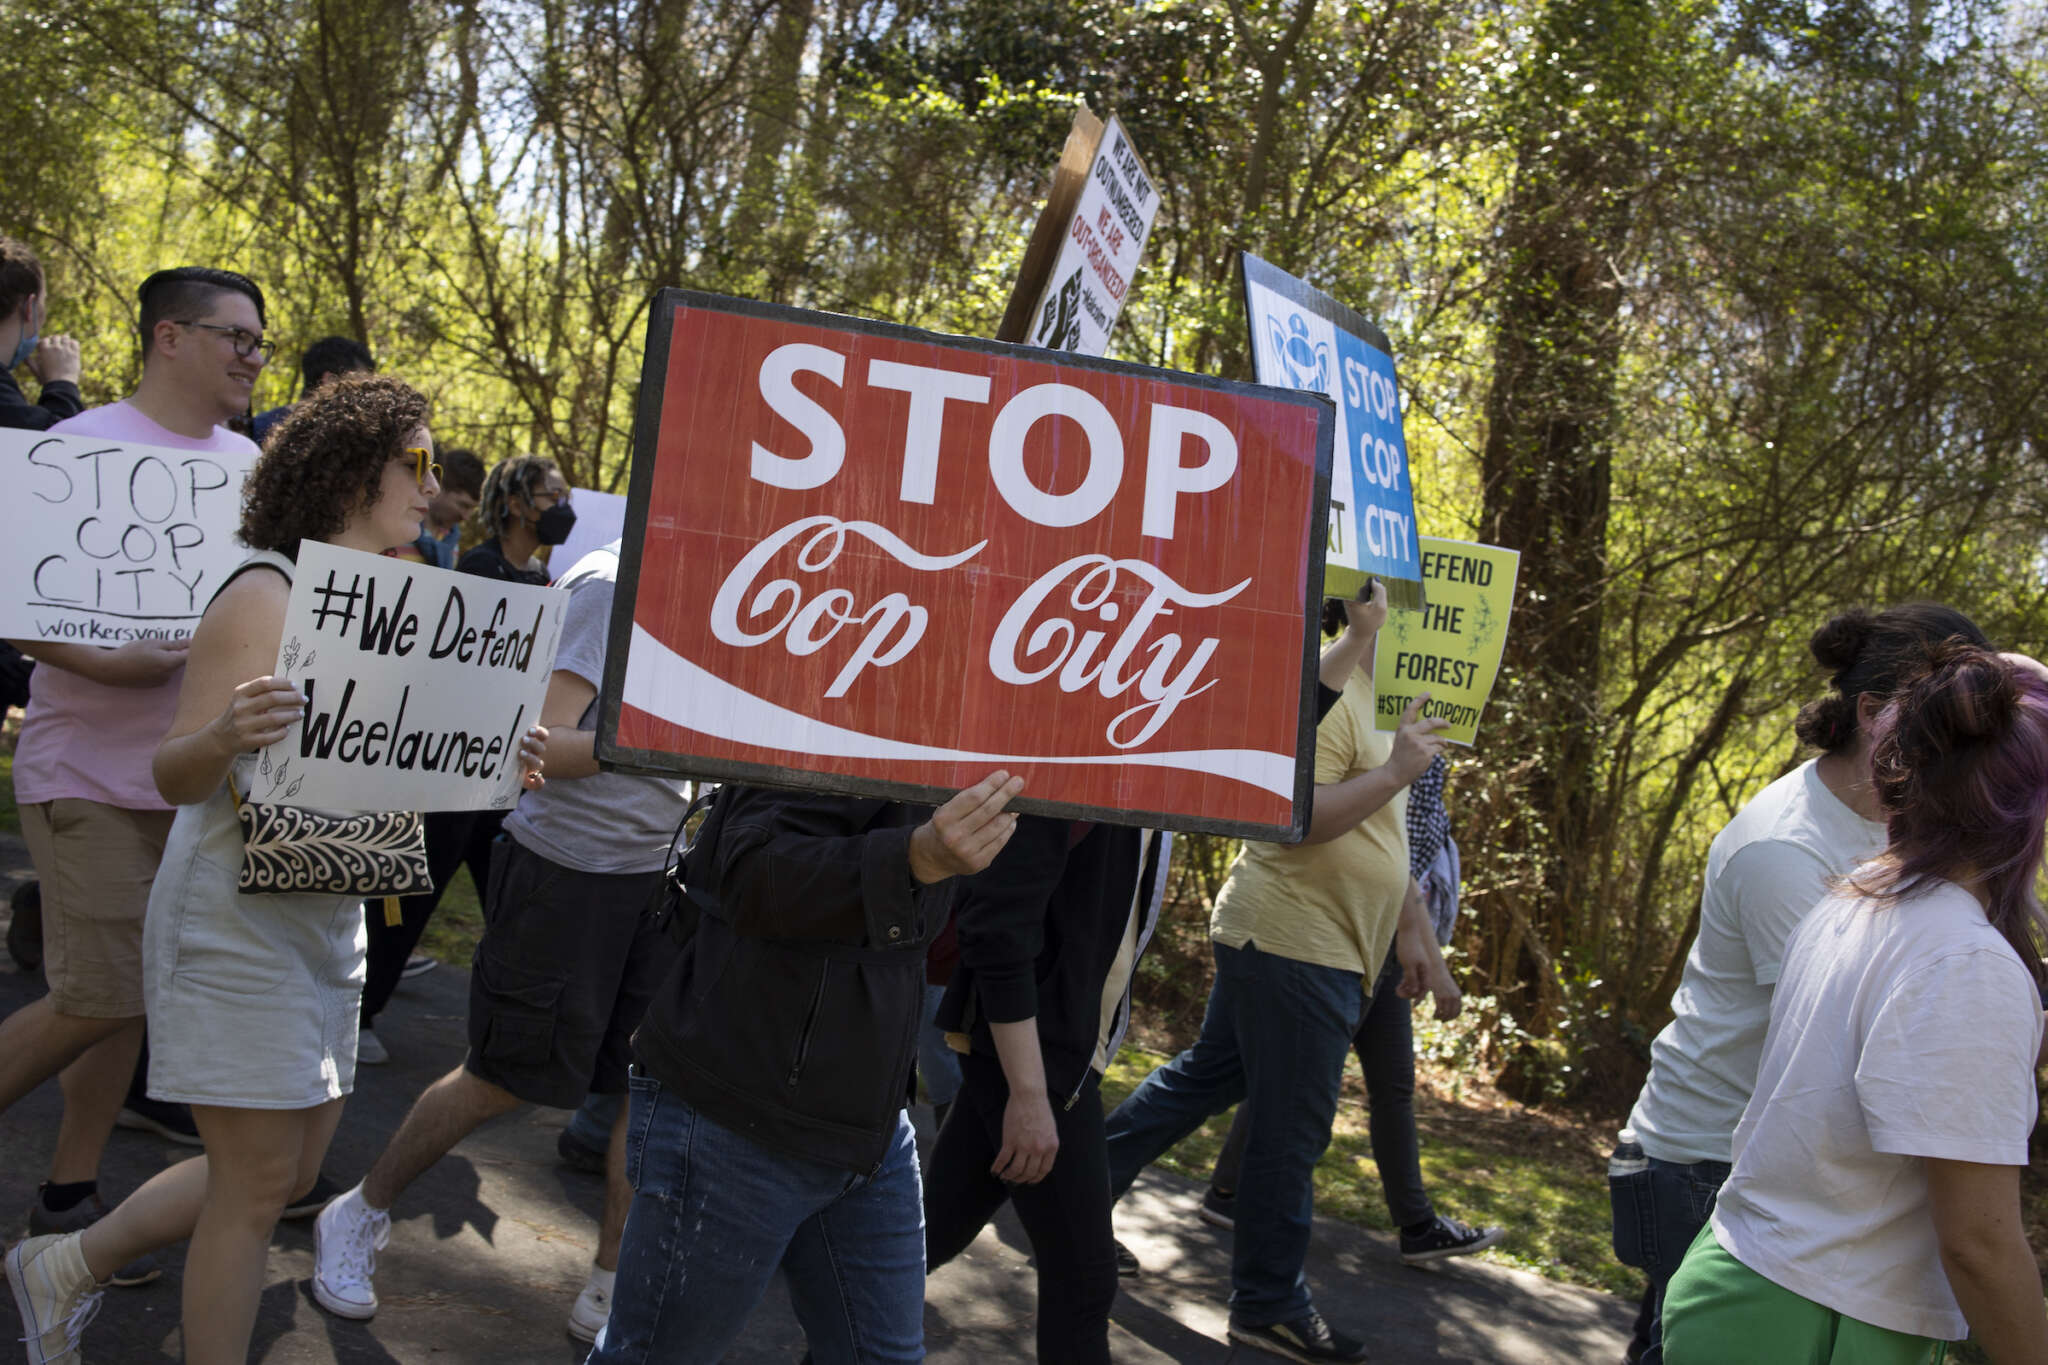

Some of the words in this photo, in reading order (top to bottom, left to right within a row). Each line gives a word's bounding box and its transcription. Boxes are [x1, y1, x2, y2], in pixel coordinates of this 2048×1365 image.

[1096, 155, 1144, 248] OUTNUMBERED,
[1121, 152, 1138, 187] ARE
[1133, 173, 1151, 208] NOT
[1072, 214, 1128, 304] OUT-ORGANIZED!
[1097, 204, 1111, 238] WE
[1106, 222, 1124, 256] ARE
[1345, 356, 1396, 424] STOP
[749, 343, 1239, 539] STOP
[1360, 432, 1401, 491] COP
[28, 438, 229, 524] STOP
[77, 517, 204, 570] COP
[1365, 504, 1410, 562] CITY
[34, 555, 203, 611] CITY
[1422, 552, 1493, 587] EFEND
[312, 570, 418, 657] #We
[429, 585, 544, 673] Defend
[710, 515, 988, 698] Cop
[988, 554, 1252, 750] City
[1422, 603, 1464, 634] THE
[1395, 652, 1479, 690] FOREST
[300, 679, 524, 782] Weelaunee!
[1378, 694, 1480, 728] #STOCOPCITY
